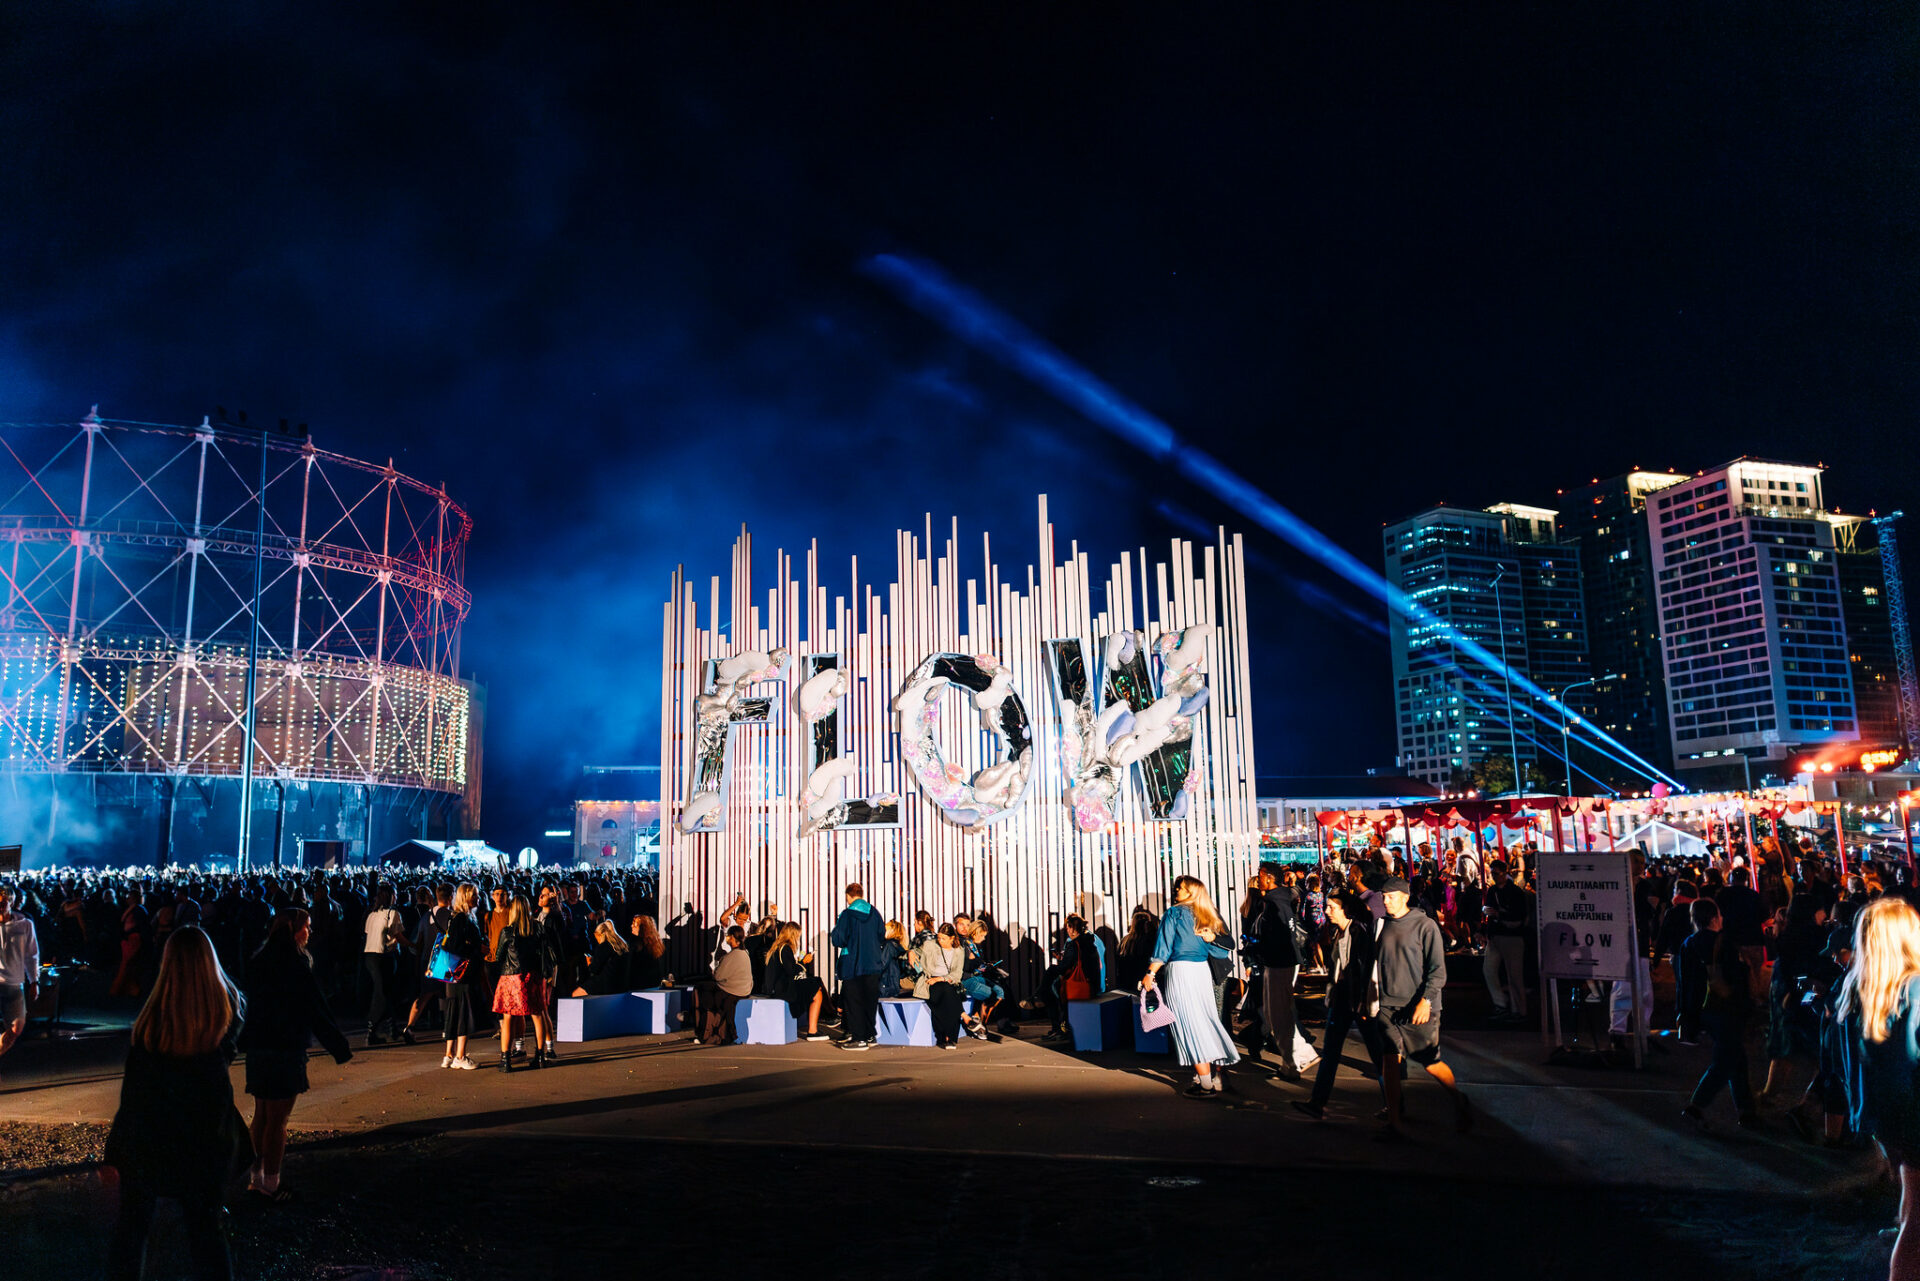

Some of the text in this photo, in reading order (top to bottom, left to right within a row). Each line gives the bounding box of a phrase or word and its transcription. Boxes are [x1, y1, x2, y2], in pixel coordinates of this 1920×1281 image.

[682, 624, 1212, 835] FLOW
[1547, 880, 1619, 891] LAURATIMANTTI
[1573, 903, 1595, 912] EETU
[1556, 911, 1613, 921] KEMPPAINEN
